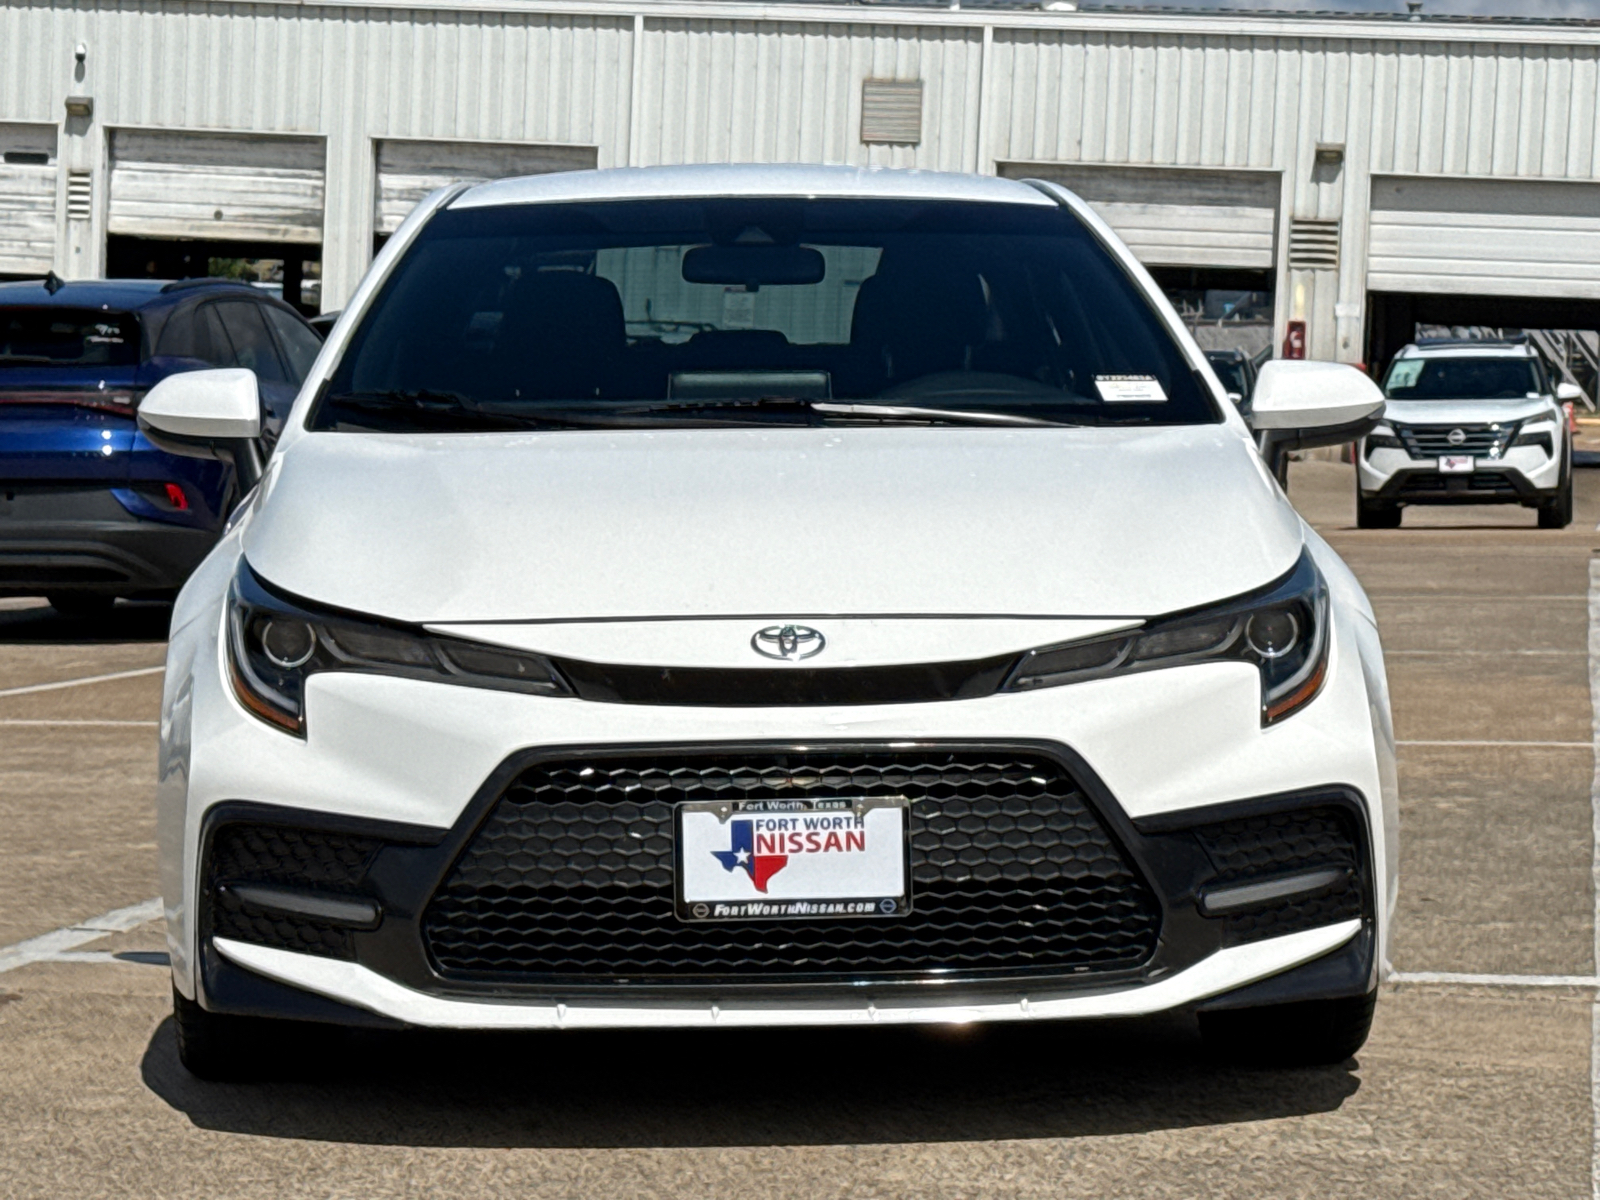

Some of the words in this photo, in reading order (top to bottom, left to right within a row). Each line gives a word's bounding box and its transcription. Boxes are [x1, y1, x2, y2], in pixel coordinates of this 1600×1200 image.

[738, 801, 764, 811] Fort
[812, 800, 847, 811] Texas
[756, 818, 800, 832] FORT
[803, 816, 865, 831] WORTH
[756, 831, 866, 854] NISSAN
